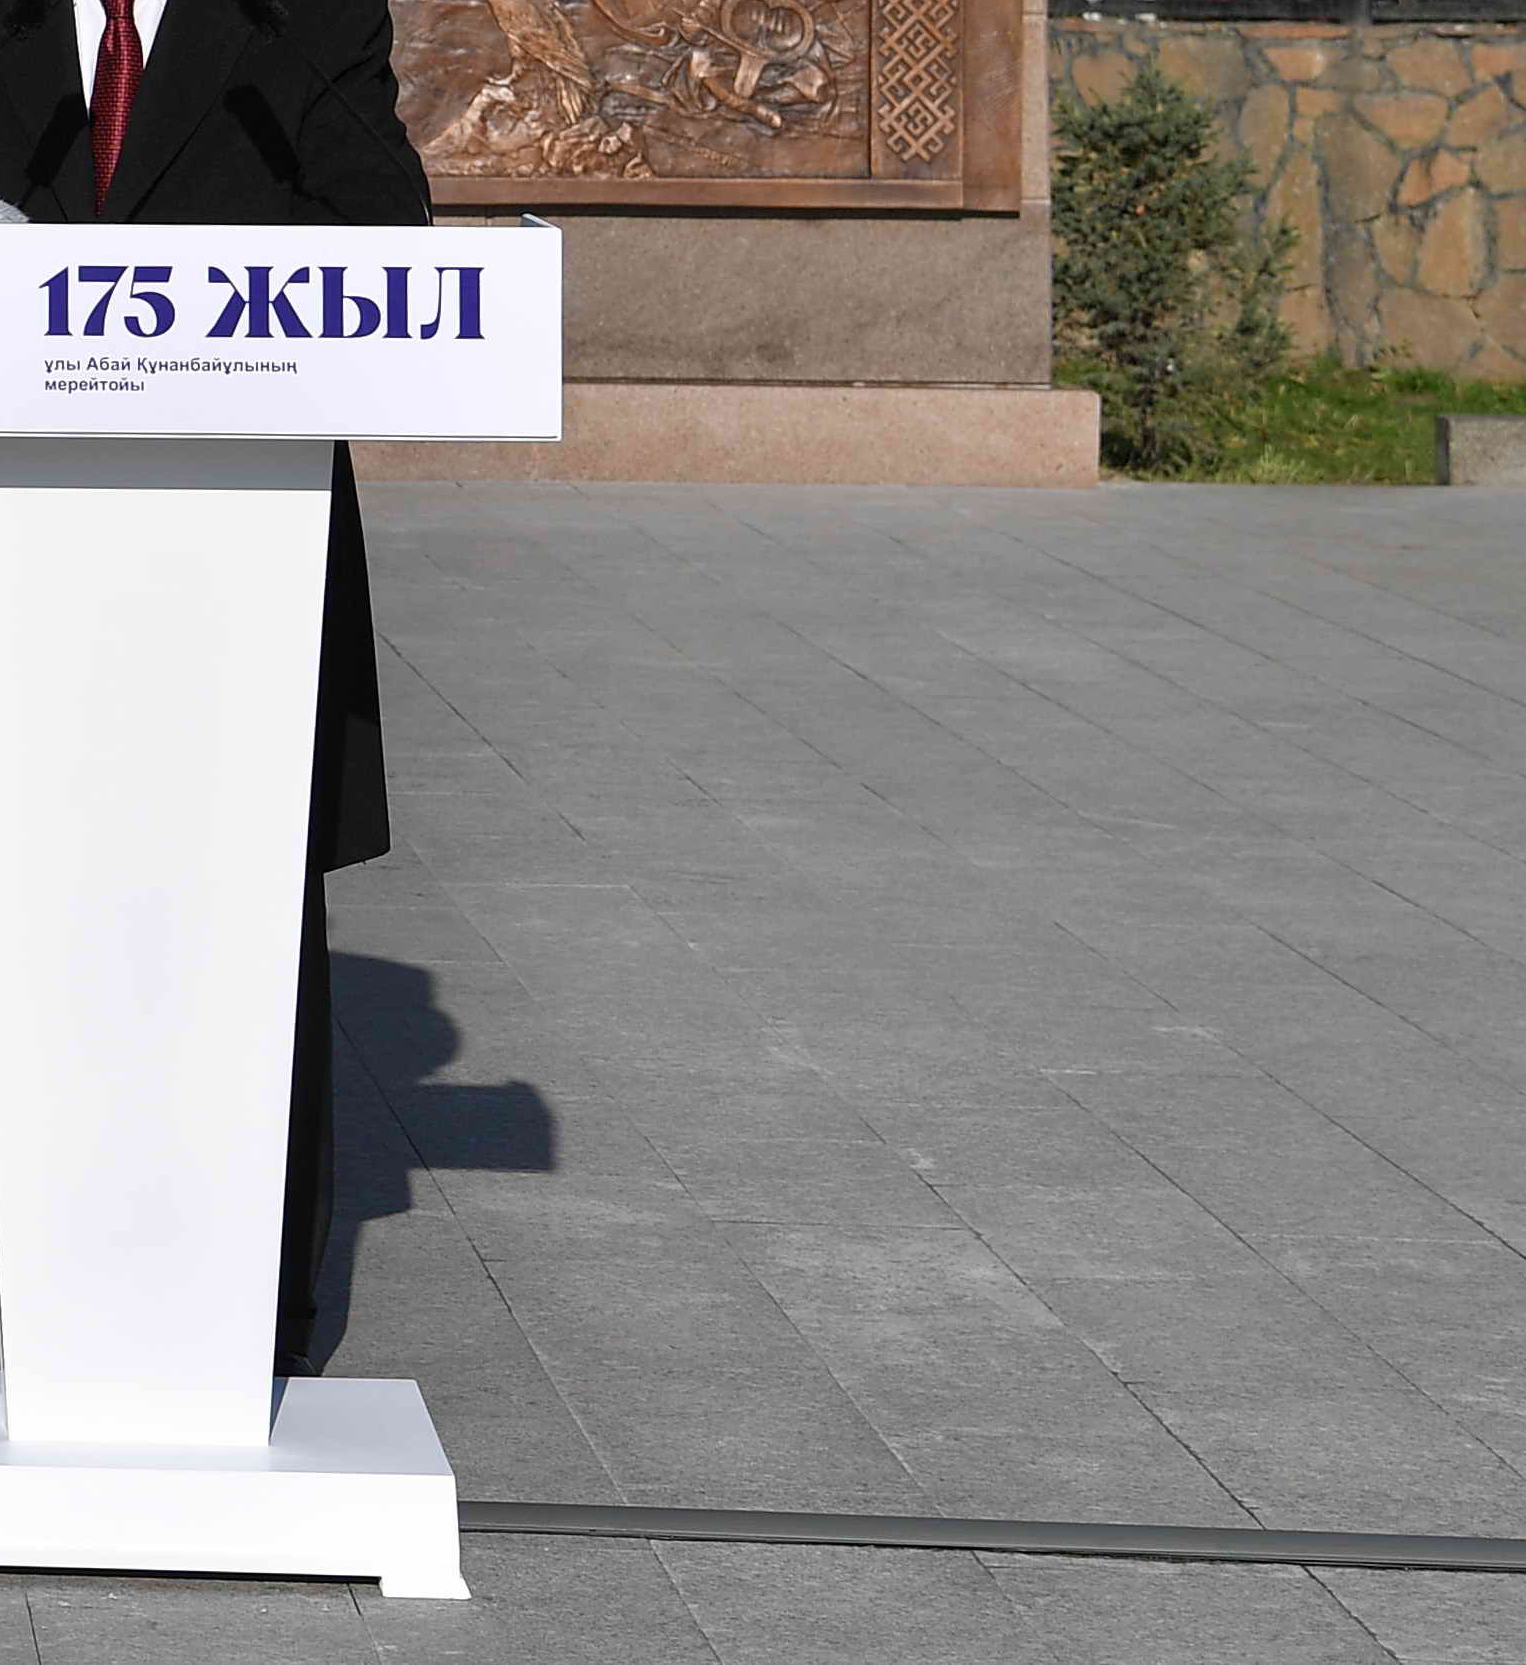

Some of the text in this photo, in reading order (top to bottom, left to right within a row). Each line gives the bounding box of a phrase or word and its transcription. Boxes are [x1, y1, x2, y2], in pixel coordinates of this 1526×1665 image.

[38, 265, 486, 340] 175 ЖЫЛ
[86, 357, 131, 371] Абай
[137, 357, 298, 374] Құнанбайұлының
[44, 377, 145, 393] мерейтойы
